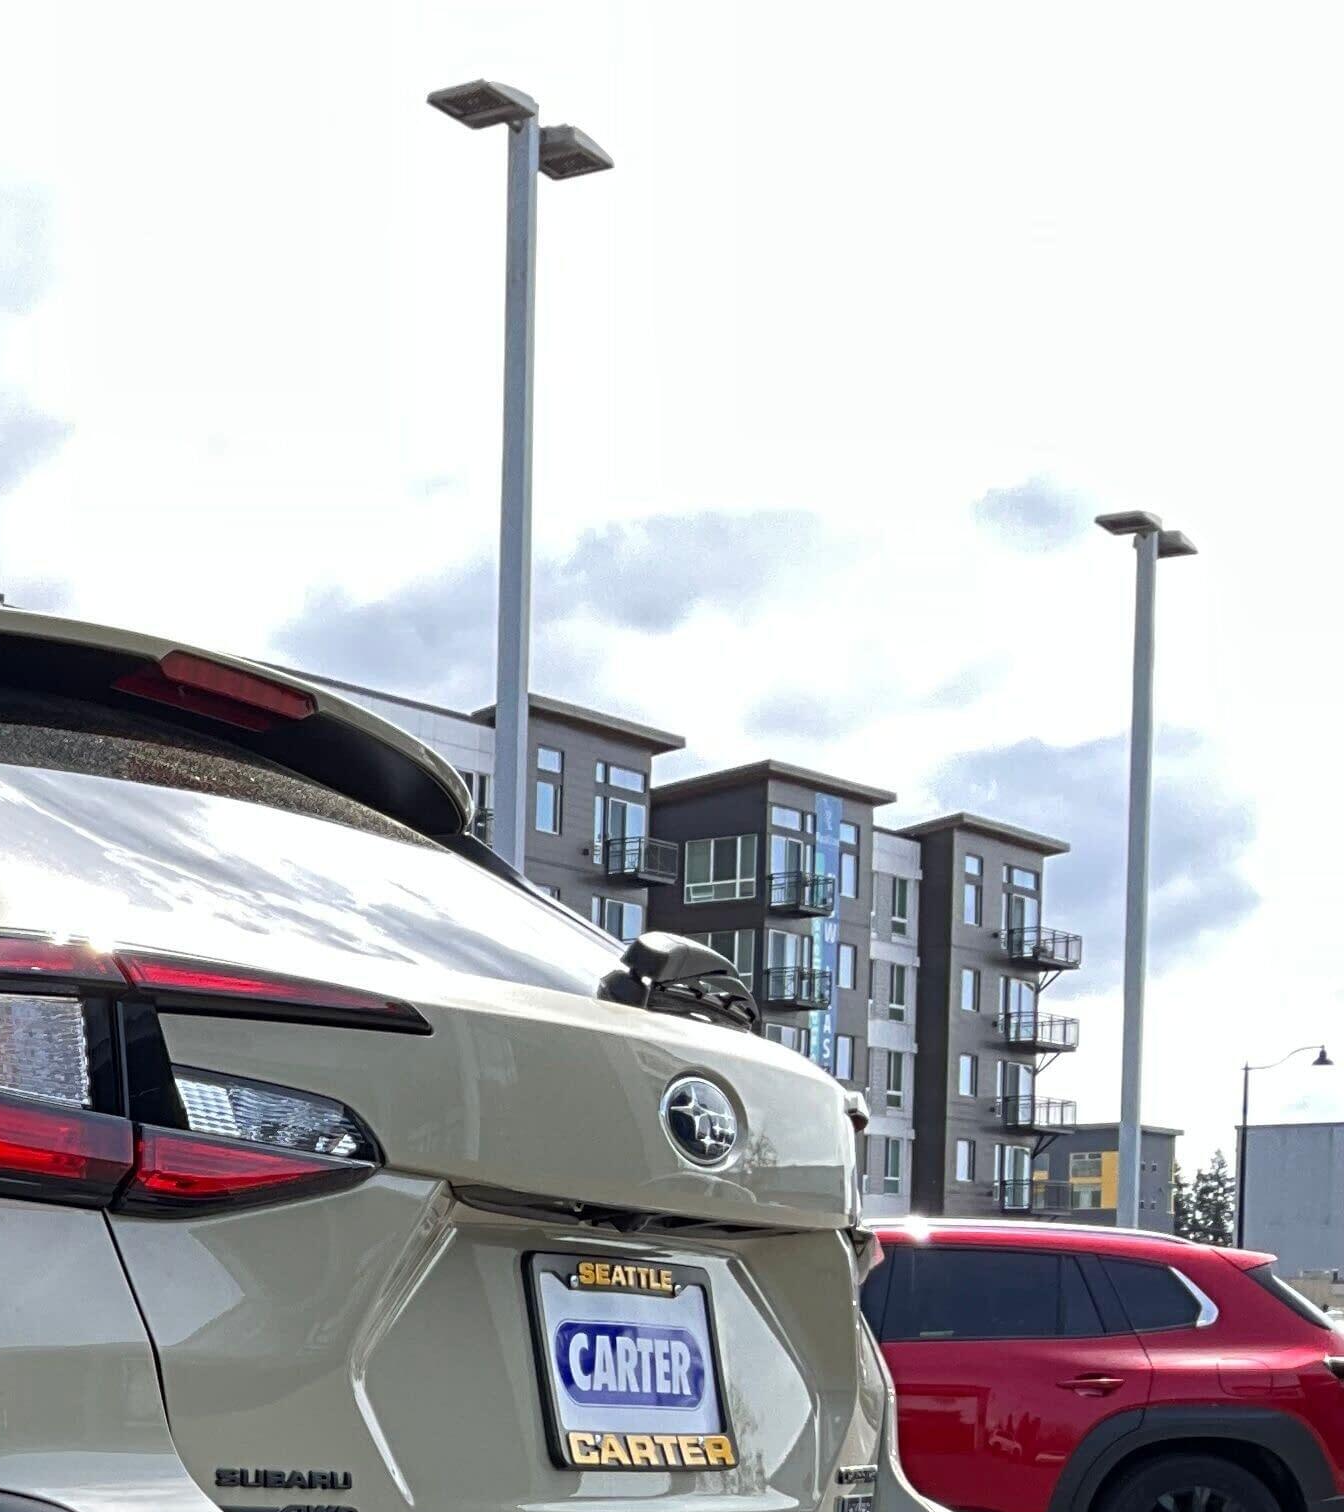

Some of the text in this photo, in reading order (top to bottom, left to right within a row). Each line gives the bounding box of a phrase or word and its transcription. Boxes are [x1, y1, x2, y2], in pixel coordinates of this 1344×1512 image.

[578, 1261, 674, 1293] SEATTLE
[568, 1331, 692, 1396] CARTER
[567, 1430, 736, 1468] CARTER
[214, 1467, 353, 1490] SUBARU
